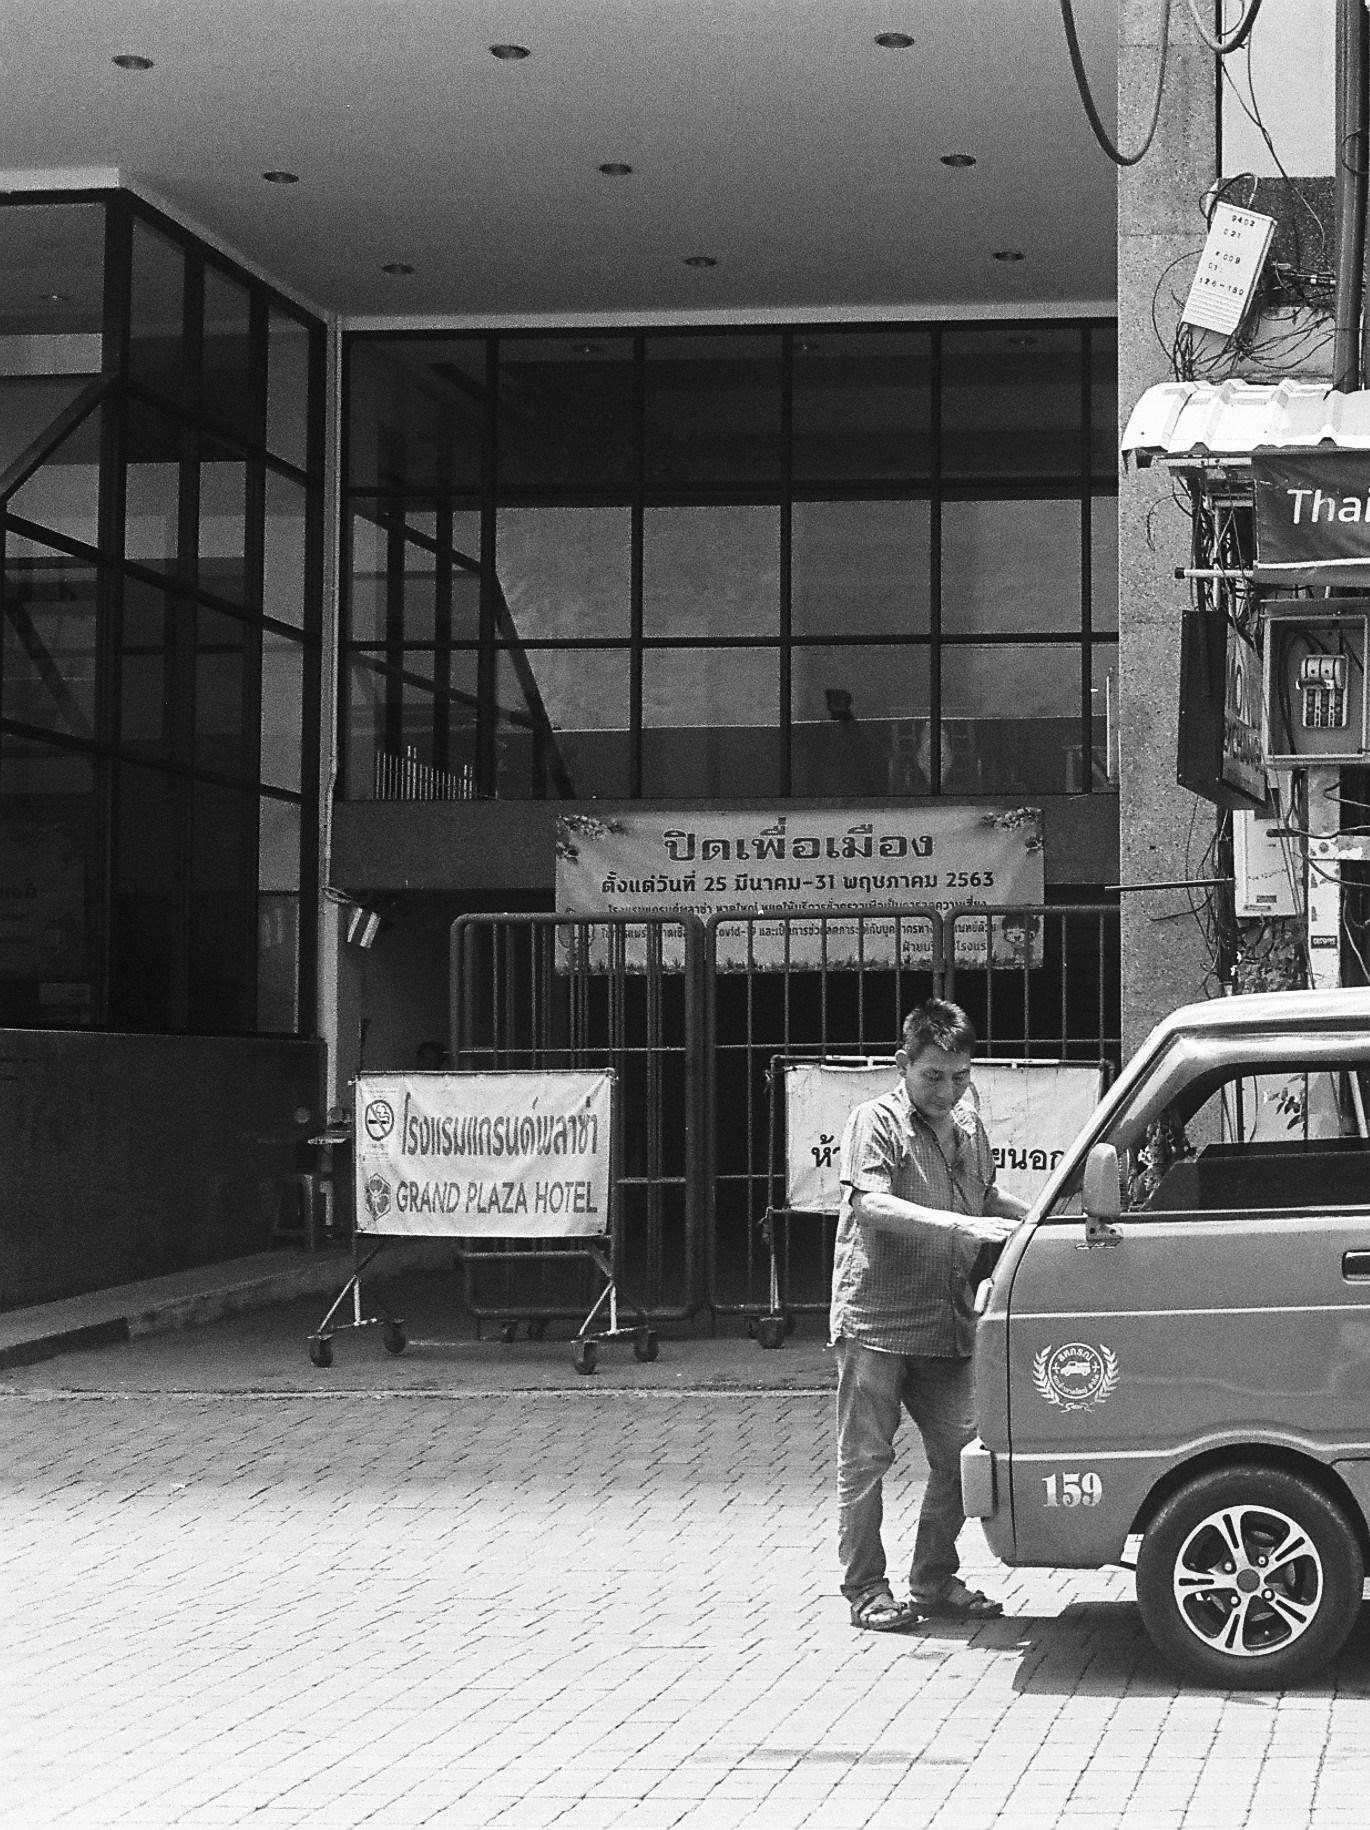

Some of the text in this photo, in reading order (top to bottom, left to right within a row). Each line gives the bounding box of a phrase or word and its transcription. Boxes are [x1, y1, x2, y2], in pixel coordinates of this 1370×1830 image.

[663, 817, 934, 863] ปิดเพื่อเมือง
[602, 870, 696, 893] ตั้งแต่วันที่
[704, 875, 727, 892] 25
[843, 872, 938, 895] พฤษภาคม
[945, 870, 995, 889] 2563
[396, 1180, 598, 1213] GRAND PLAZA HOTEL
[1041, 1471, 1103, 1508] 159
